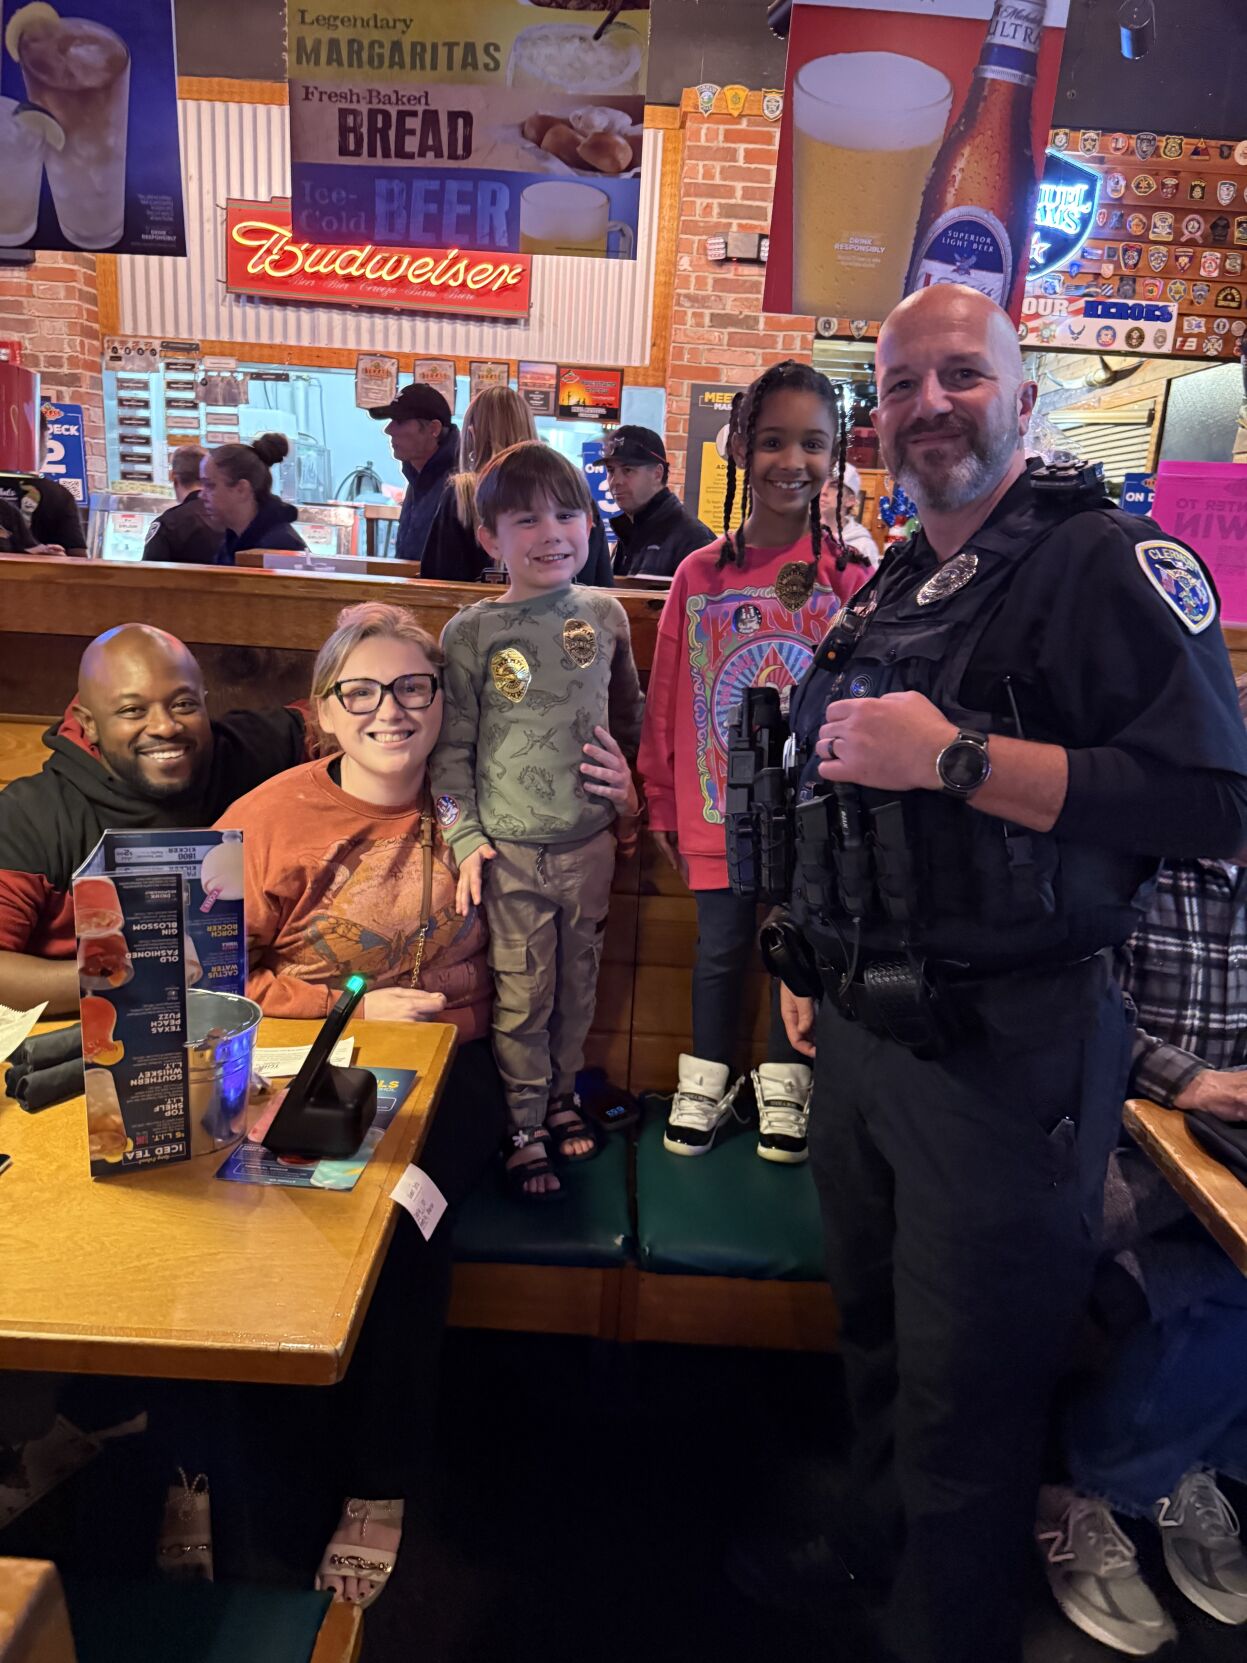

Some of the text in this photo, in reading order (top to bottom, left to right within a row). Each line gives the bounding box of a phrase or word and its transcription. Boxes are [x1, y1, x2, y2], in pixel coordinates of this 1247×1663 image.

[298, 9, 414, 34] Legendary
[296, 36, 501, 72] MARGARITAS
[302, 85, 430, 107] Fresh-Baked
[337, 107, 474, 160] BREAD
[301, 178, 511, 247] Ice- BEER
[301, 208, 368, 235] Cold
[947, 230, 991, 244] SUPERIOR
[942, 237, 994, 252] LIGHT BEER
[231, 221, 527, 291] Budweiser
[1021, 297, 1069, 317] OUR
[40, 440, 67, 474] 2
[585, 463, 604, 474] ON
[1125, 492, 1145, 502] ON
[706, 596, 836, 670] PNK
[132, 922, 178, 931] BLOSSOM
[125, 949, 179, 959] FASHIONED
[207, 970, 239, 979] CACTUS
[150, 1019, 182, 1027] PEACH
[151, 1025, 182, 1034] TEXAS
[138, 1068, 183, 1078] WHISKEY
[130, 1074, 183, 1087] SOUTHERN
[153, 1102, 184, 1113] SHELF
[164, 1109, 184, 1117] TOP
[126, 1143, 183, 1160] ICED TEA
